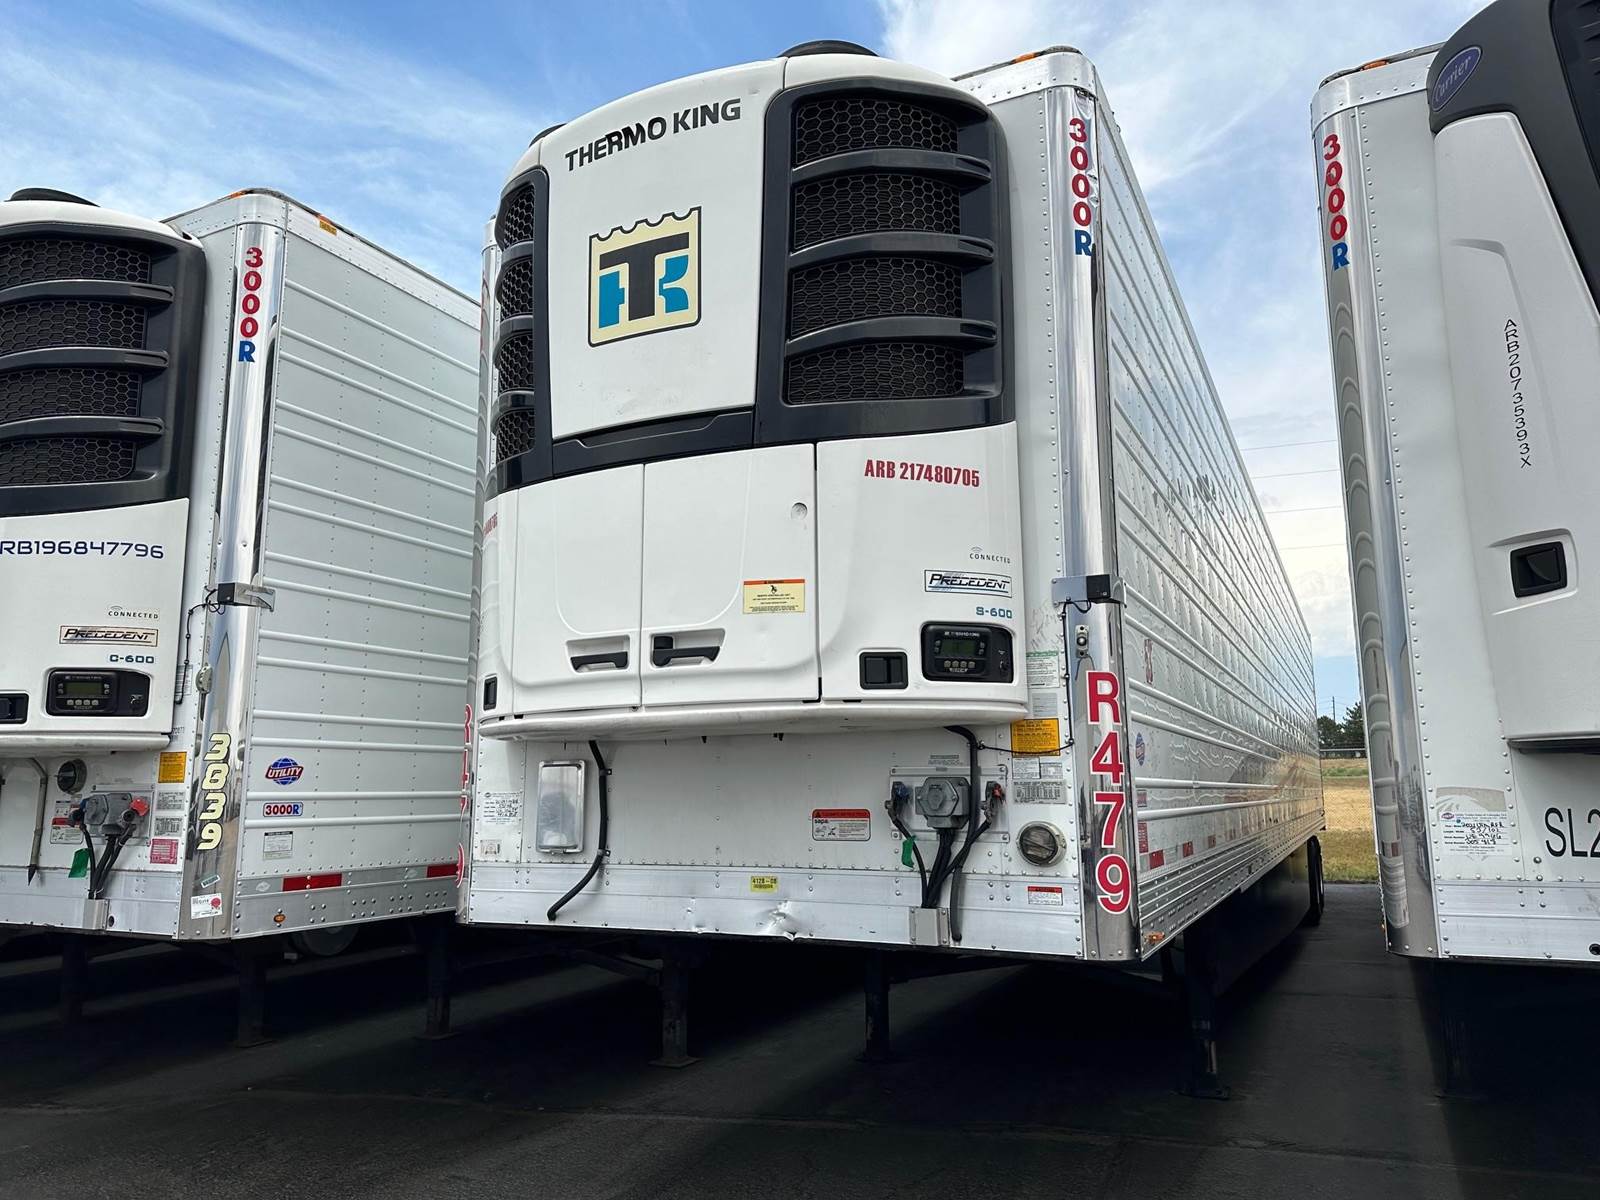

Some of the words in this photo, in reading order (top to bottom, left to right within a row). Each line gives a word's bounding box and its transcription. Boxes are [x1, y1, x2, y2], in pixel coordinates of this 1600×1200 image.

[565, 115, 667, 172] THERMO
[672, 97, 741, 135] KING
[1069, 117, 1093, 257] 3000R
[1323, 133, 1350, 271] 3000R
[238, 246, 264, 363] 3000R
[864, 458, 896, 479] ARB
[899, 461, 980, 488] 217480705
[968, 552, 1011, 564] CONNECTED
[107, 610, 159, 620] CONNECTED
[975, 606, 1013, 619] S-600
[197, 733, 232, 851] 3839
[267, 766, 303, 779] UTILITY
[1086, 670, 1132, 914] R479
[265, 803, 301, 816] 3000R
